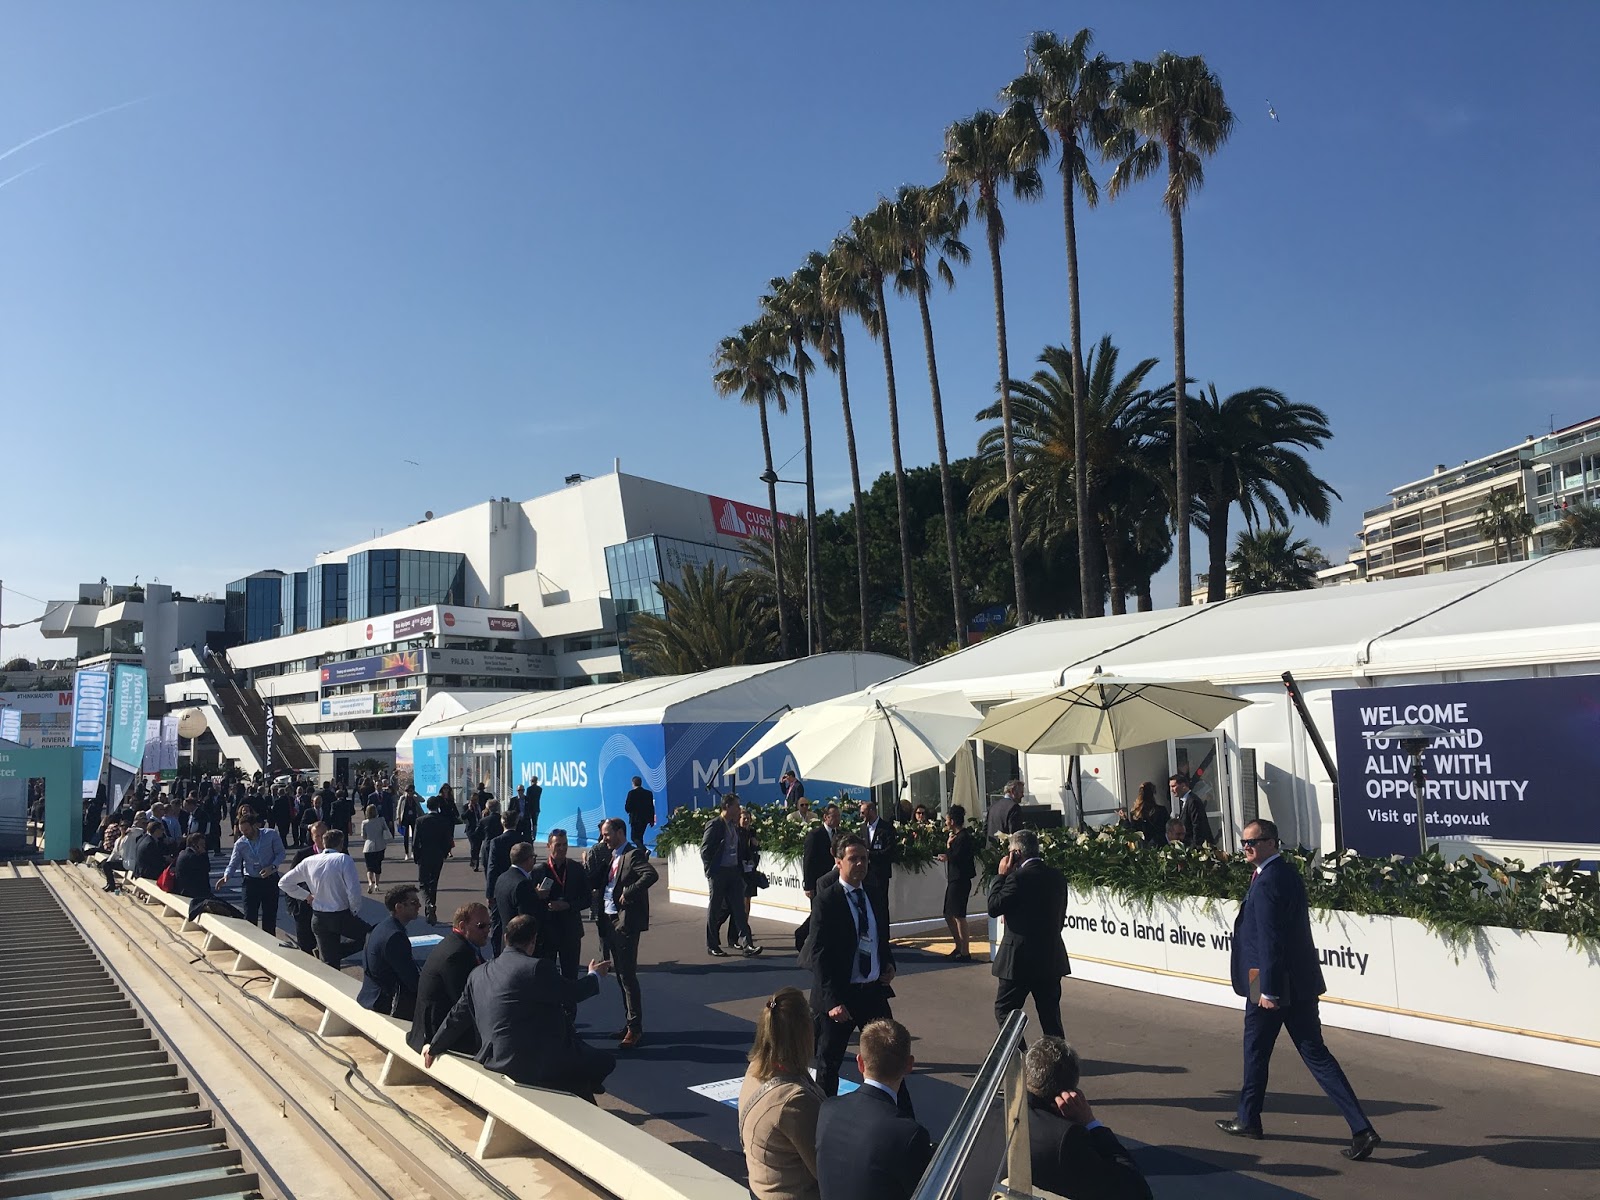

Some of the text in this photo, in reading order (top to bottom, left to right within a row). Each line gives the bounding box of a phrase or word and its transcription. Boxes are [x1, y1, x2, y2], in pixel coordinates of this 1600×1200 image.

[748, 524, 773, 540] WAK
[501, 619, 517, 629] étage
[451, 657, 470, 665] PALAIS
[76, 674, 106, 742] LONDON
[120, 671, 133, 727] Pavilion
[131, 673, 145, 753] Manchester
[1360, 702, 1469, 726] WELCOME
[521, 761, 587, 787] MIDLANDS
[692, 754, 800, 789] MIDLA
[1433, 753, 1492, 775] WITH
[1366, 779, 1529, 801] OPPORTUNITY
[1367, 808, 1491, 827] Visit grat.gov.uk
[767, 872, 782, 886] alive
[785, 874, 800, 889] with
[1062, 912, 1369, 976] come to a land alive wit unity
